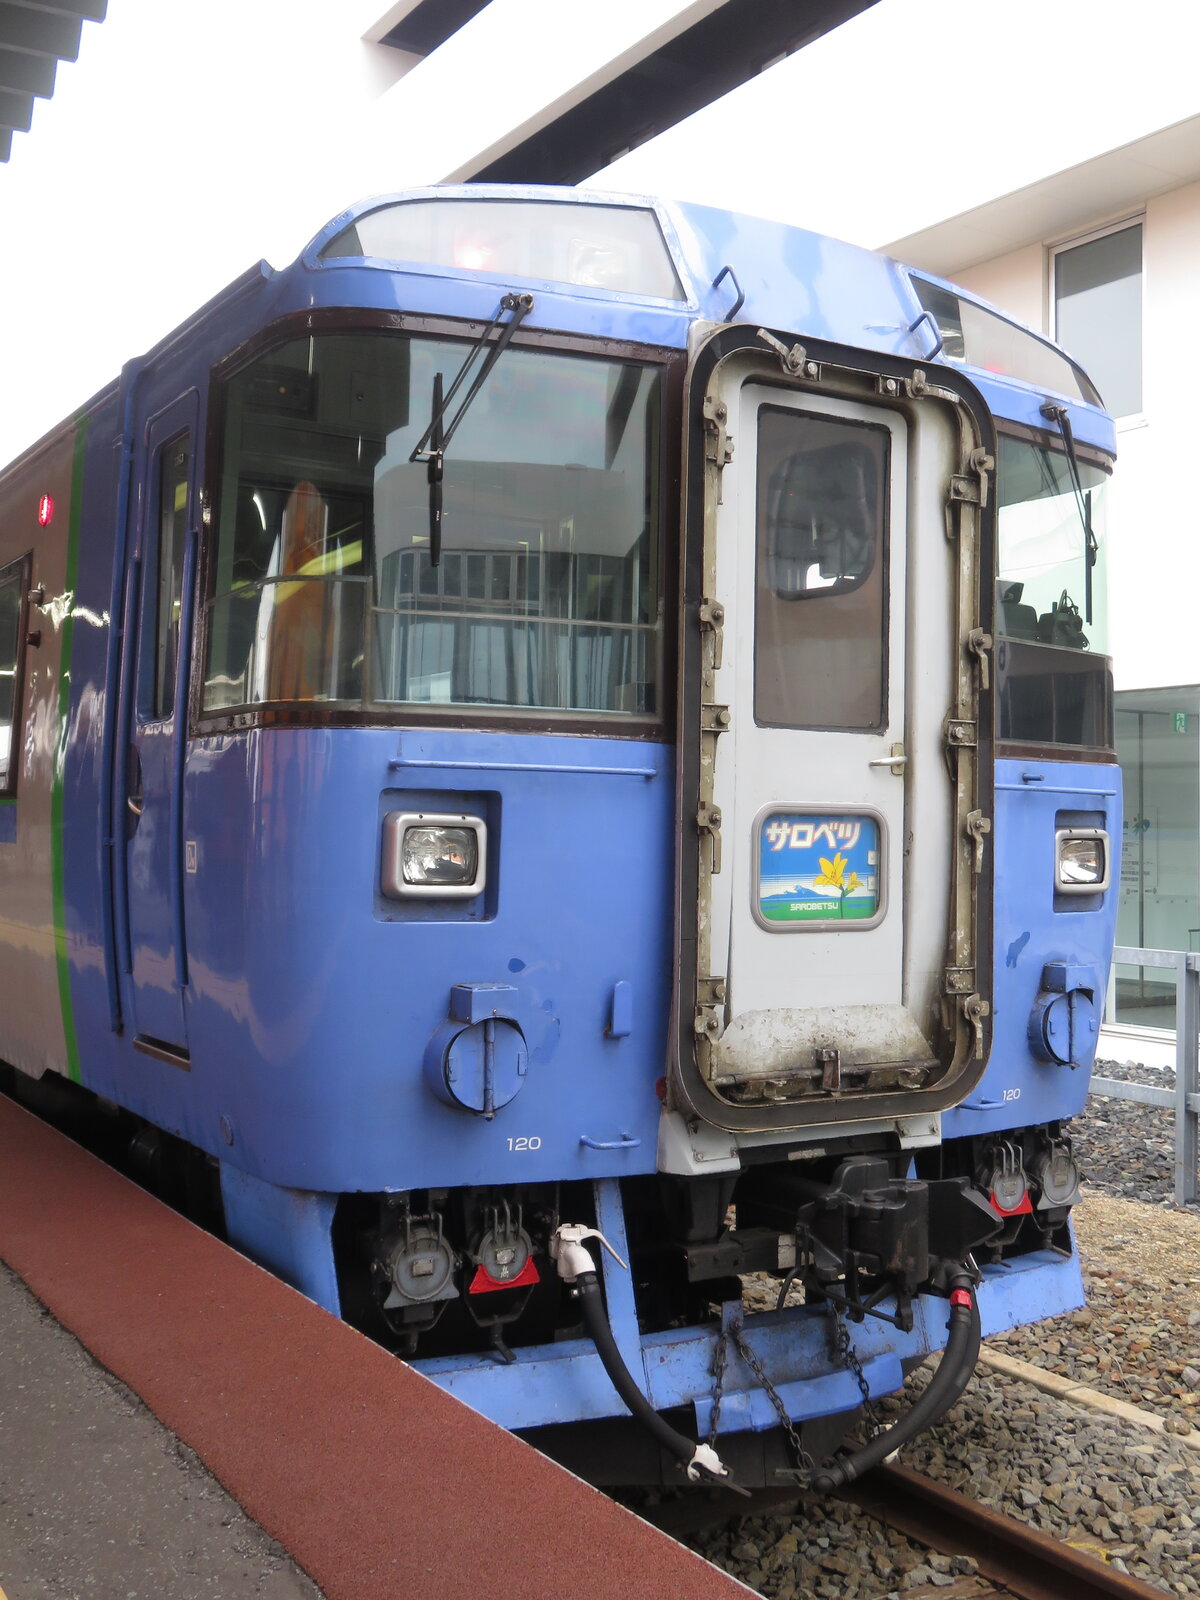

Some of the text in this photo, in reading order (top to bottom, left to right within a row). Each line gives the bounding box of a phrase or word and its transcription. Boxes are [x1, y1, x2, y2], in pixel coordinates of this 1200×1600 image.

[766, 821, 861, 851] サロベツ
[790, 902, 838, 911] SAROBETSU
[1003, 1088, 1020, 1101] 120
[507, 1136, 541, 1151] 120
